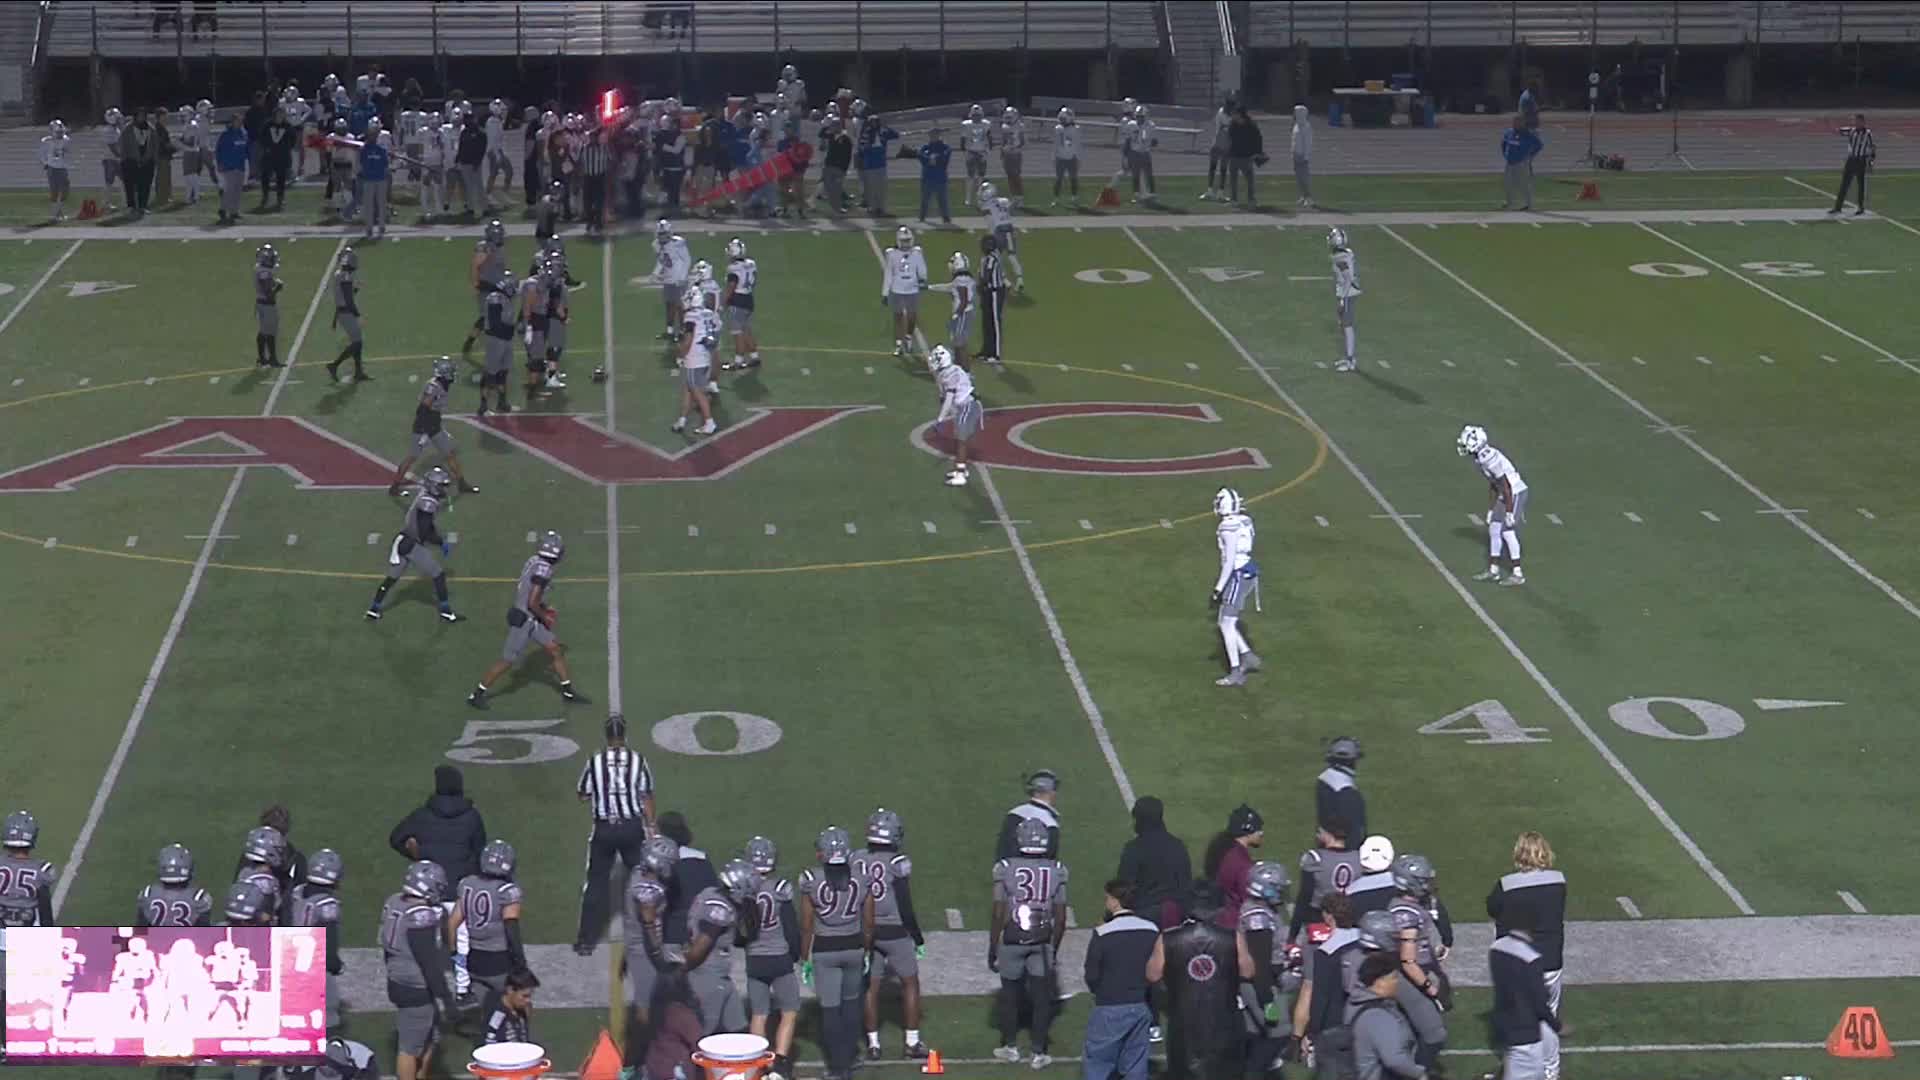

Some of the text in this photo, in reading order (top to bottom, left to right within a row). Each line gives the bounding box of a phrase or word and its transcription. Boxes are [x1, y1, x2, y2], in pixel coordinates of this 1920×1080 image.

[0, 402, 1271, 491] AVC
[444, 711, 783, 764] 50
[1416, 697, 1745, 744] 40
[1014, 866, 1051, 905] 31
[1844, 1012, 1879, 1051] 40
